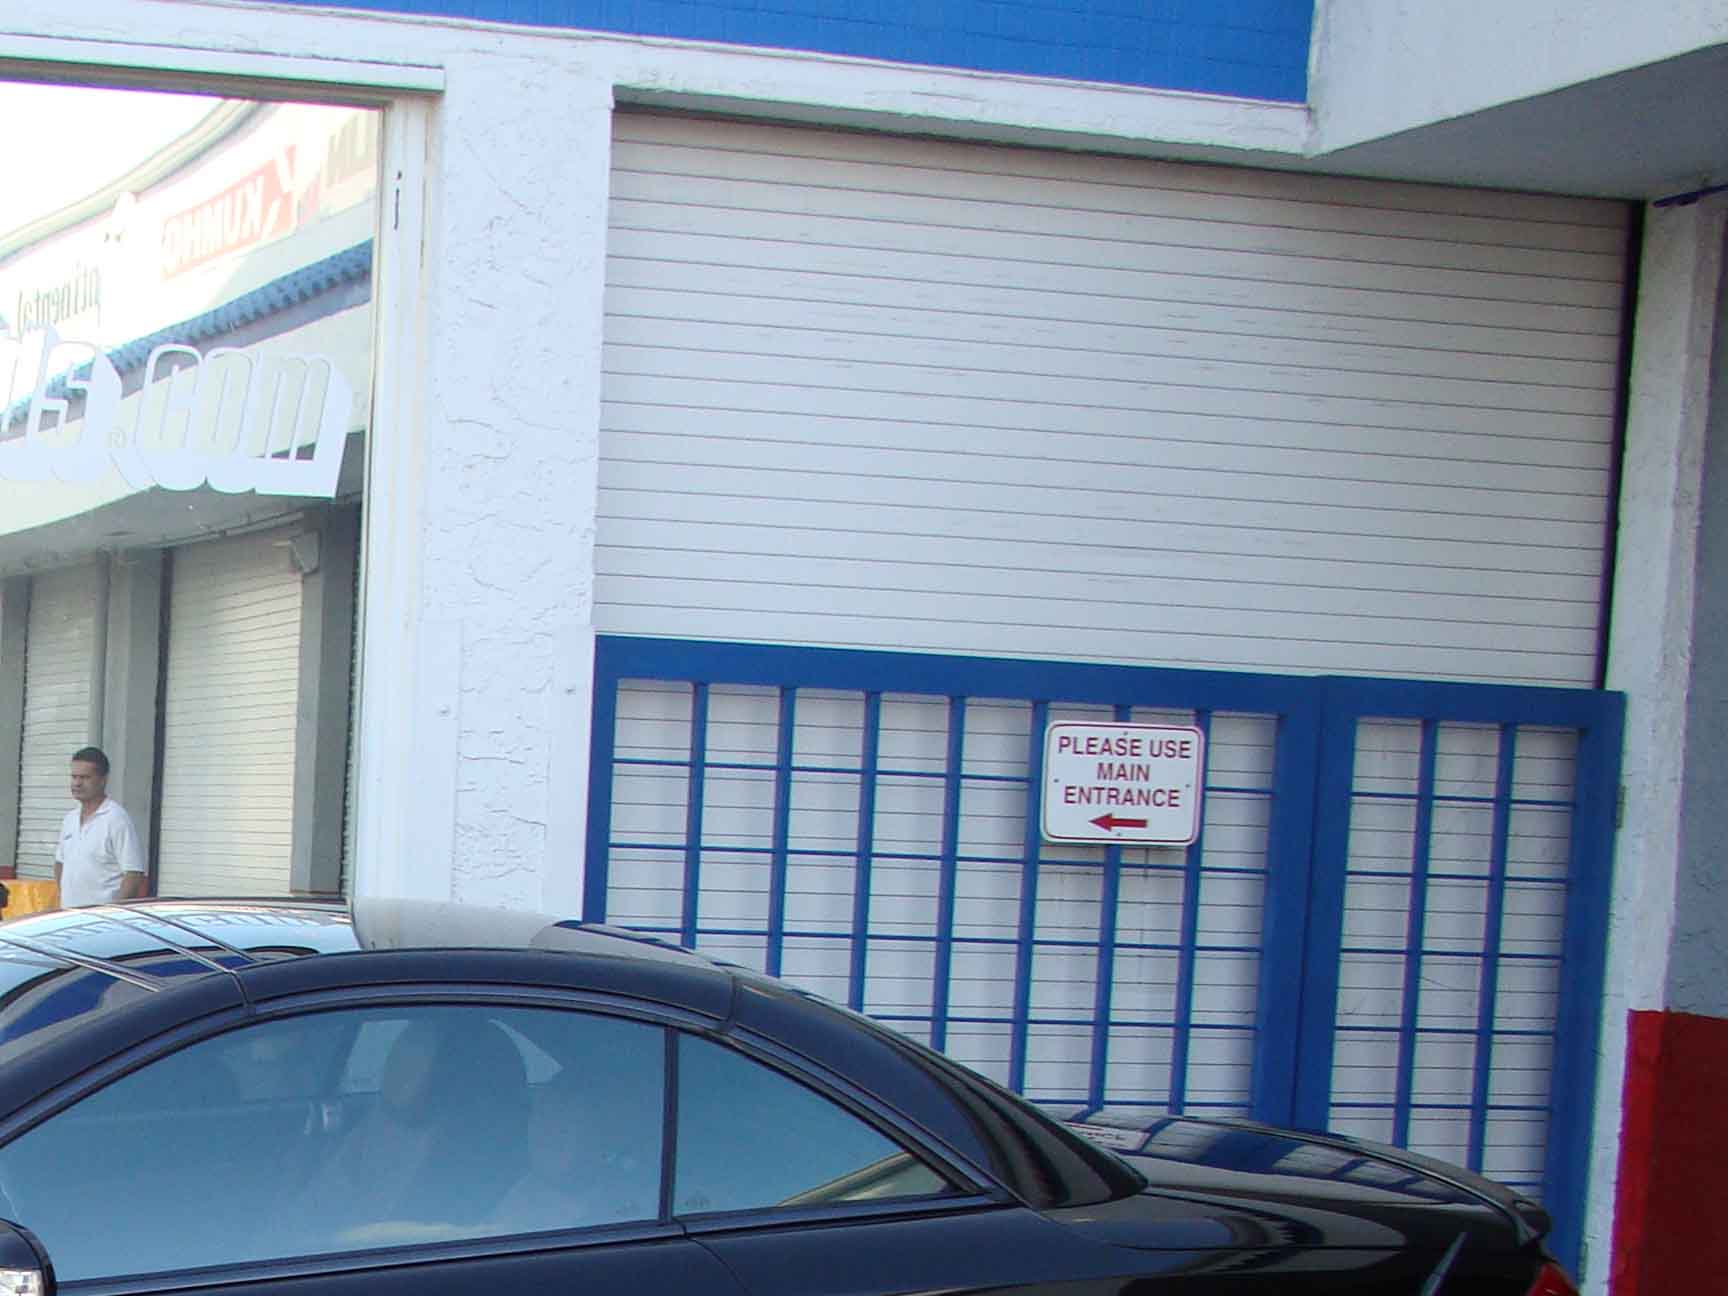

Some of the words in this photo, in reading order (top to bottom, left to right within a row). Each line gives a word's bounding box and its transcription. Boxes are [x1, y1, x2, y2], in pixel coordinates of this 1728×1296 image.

[1058, 735, 1143, 758] PLEASE
[1149, 739, 1192, 759] USE
[1096, 762, 1150, 782] MAIN
[1063, 785, 1181, 808] ENTRANCE
